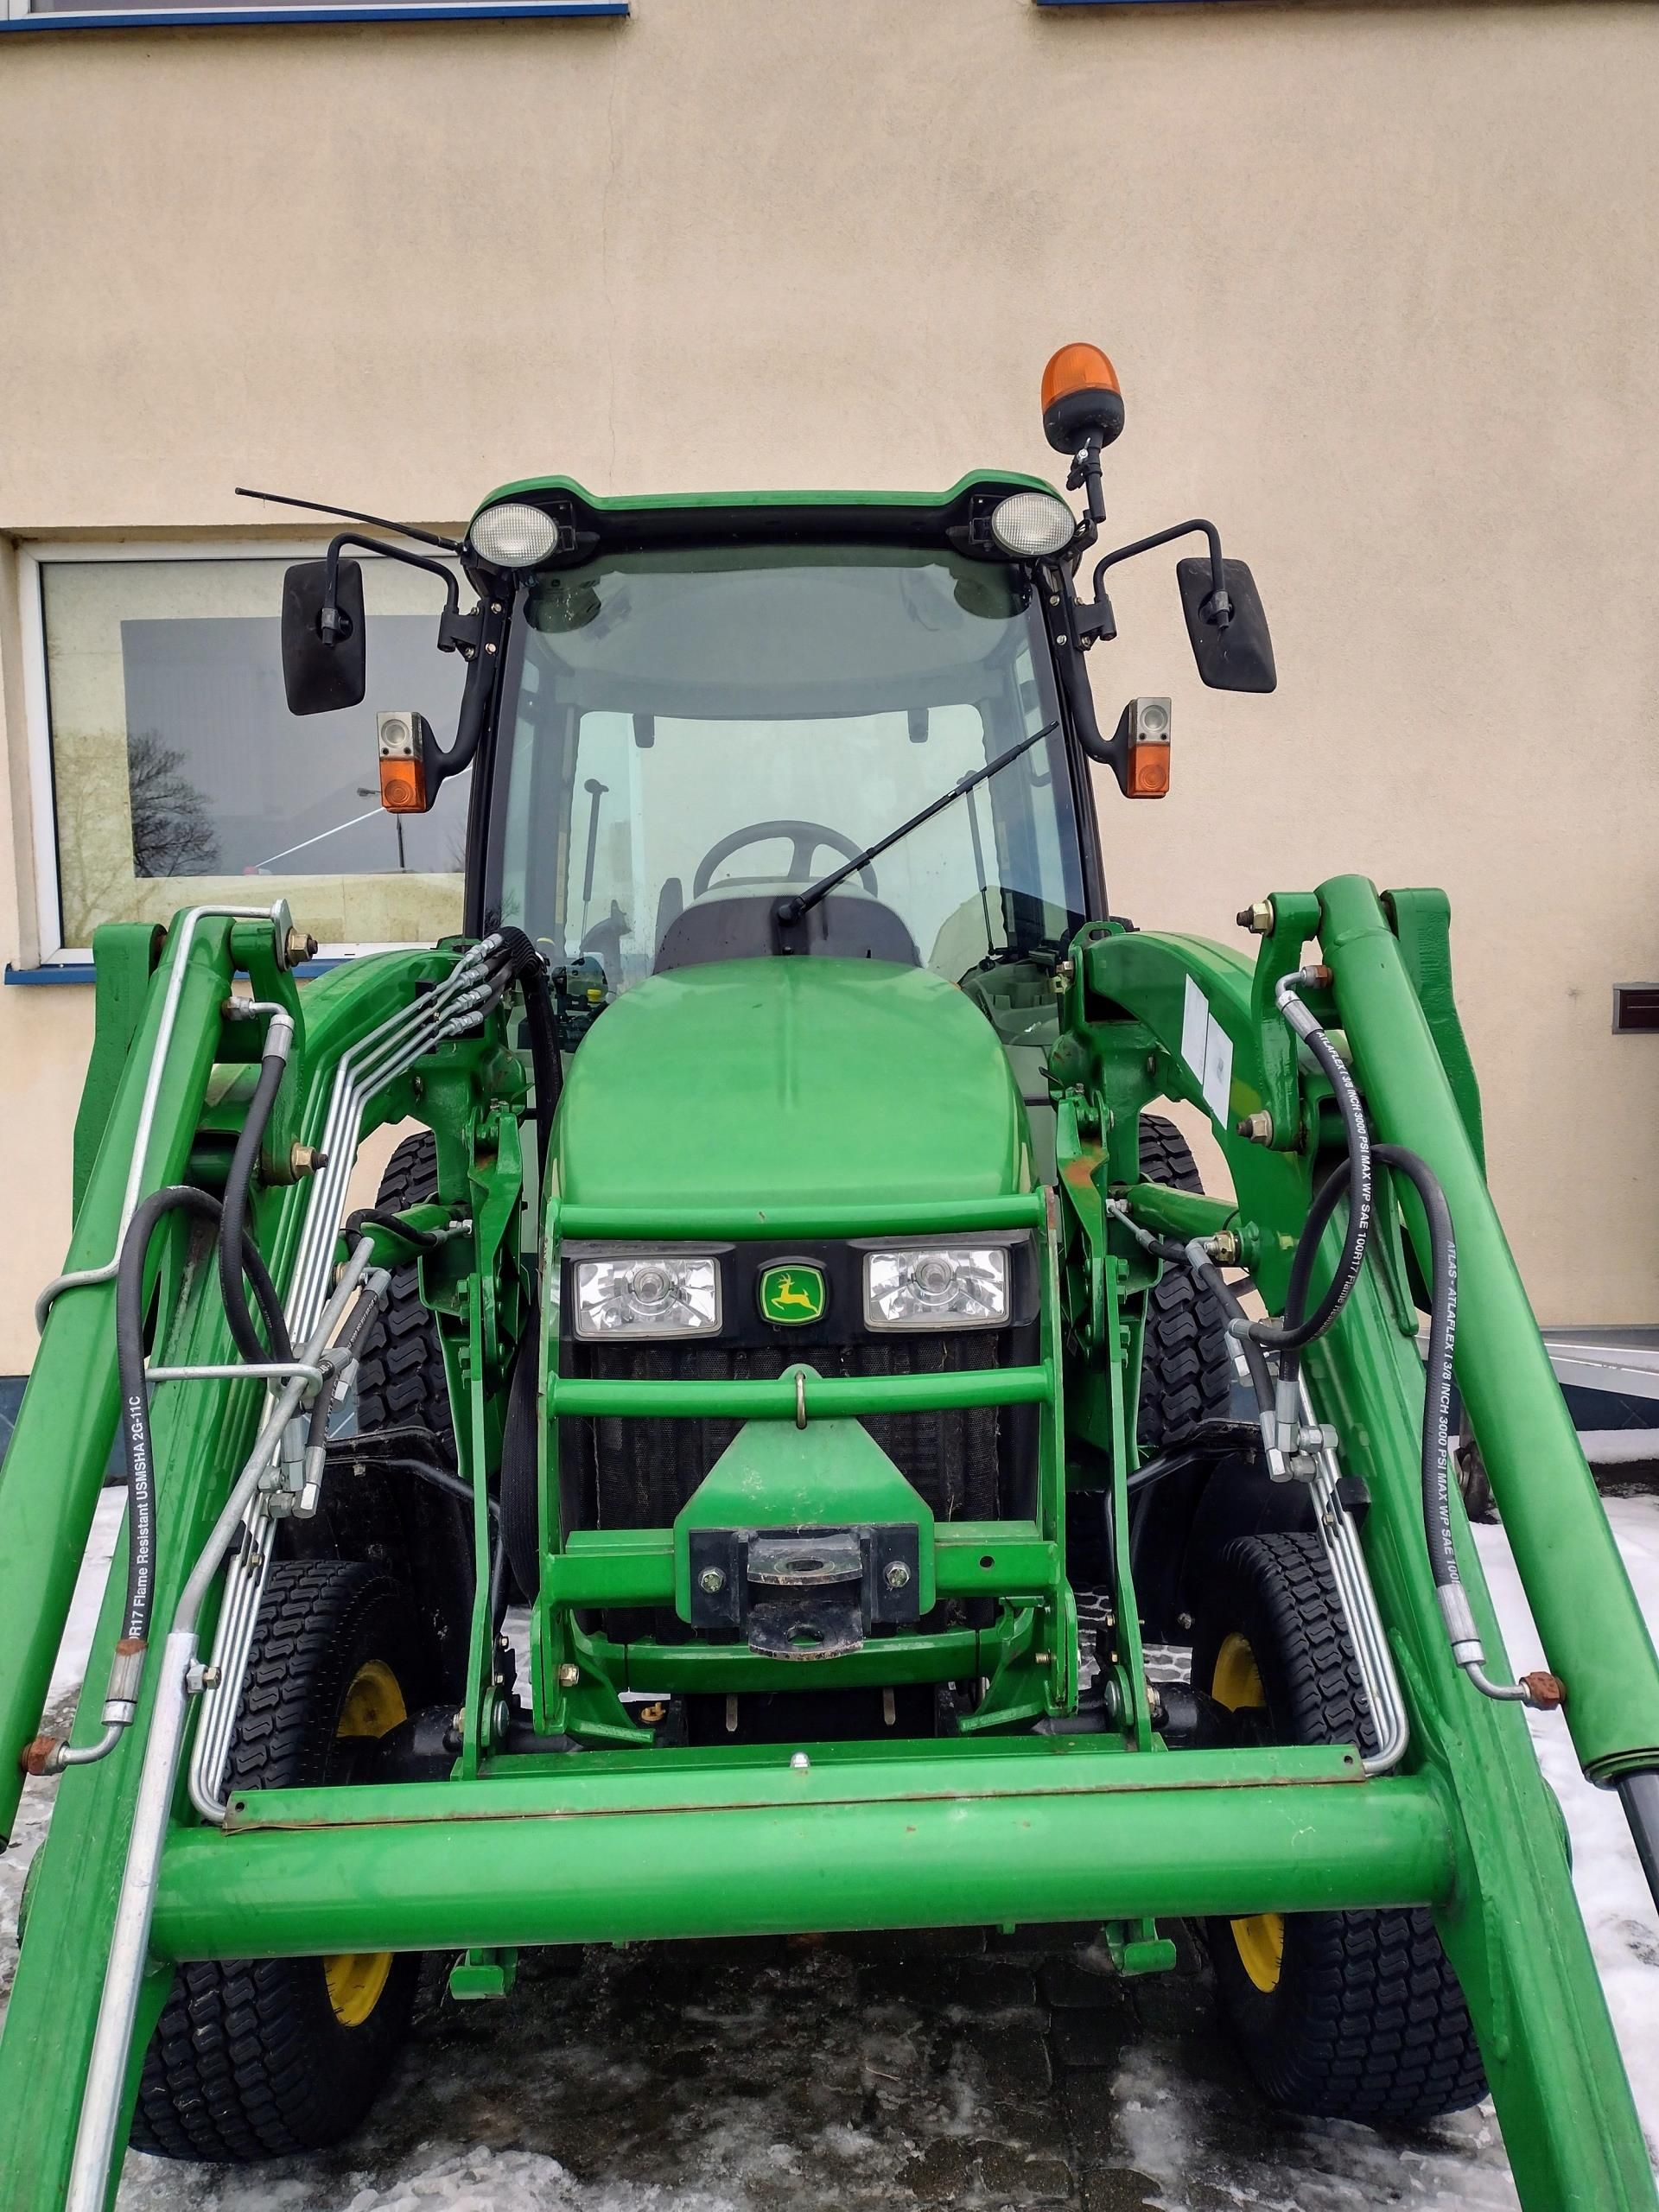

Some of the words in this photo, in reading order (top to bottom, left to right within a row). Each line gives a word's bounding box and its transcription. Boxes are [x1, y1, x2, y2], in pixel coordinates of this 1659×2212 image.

[1316, 1032, 1346, 1070] ATLAFLEX
[1347, 1089, 1362, 1110] INCH
[1354, 1112, 1366, 1134] 3000
[1358, 1136, 1370, 1153] PSI
[1361, 1155, 1371, 1179] MAX
[1362, 1183, 1371, 1201] WP
[1359, 1204, 1370, 1229] SAE
[1350, 1232, 1367, 1273] 100R17
[1446, 1240, 1457, 1279] ATLAS
[1444, 1287, 1457, 1350] ATLAFLEX
[1442, 1361, 1452, 1380] 3/8
[1440, 1382, 1451, 1414] INCH
[129, 1395, 144, 1440] 2G-11C
[1438, 1417, 1448, 1446] 3000
[133, 1442, 149, 1501] USMSHA
[1437, 1448, 1447, 1470] PSI
[1437, 1472, 1447, 1501] MAX
[1439, 1505, 1450, 1526] WP
[137, 1503, 149, 1564] Resistant
[1441, 1529, 1453, 1554] SAE
[133, 1567, 149, 1607] Flame
